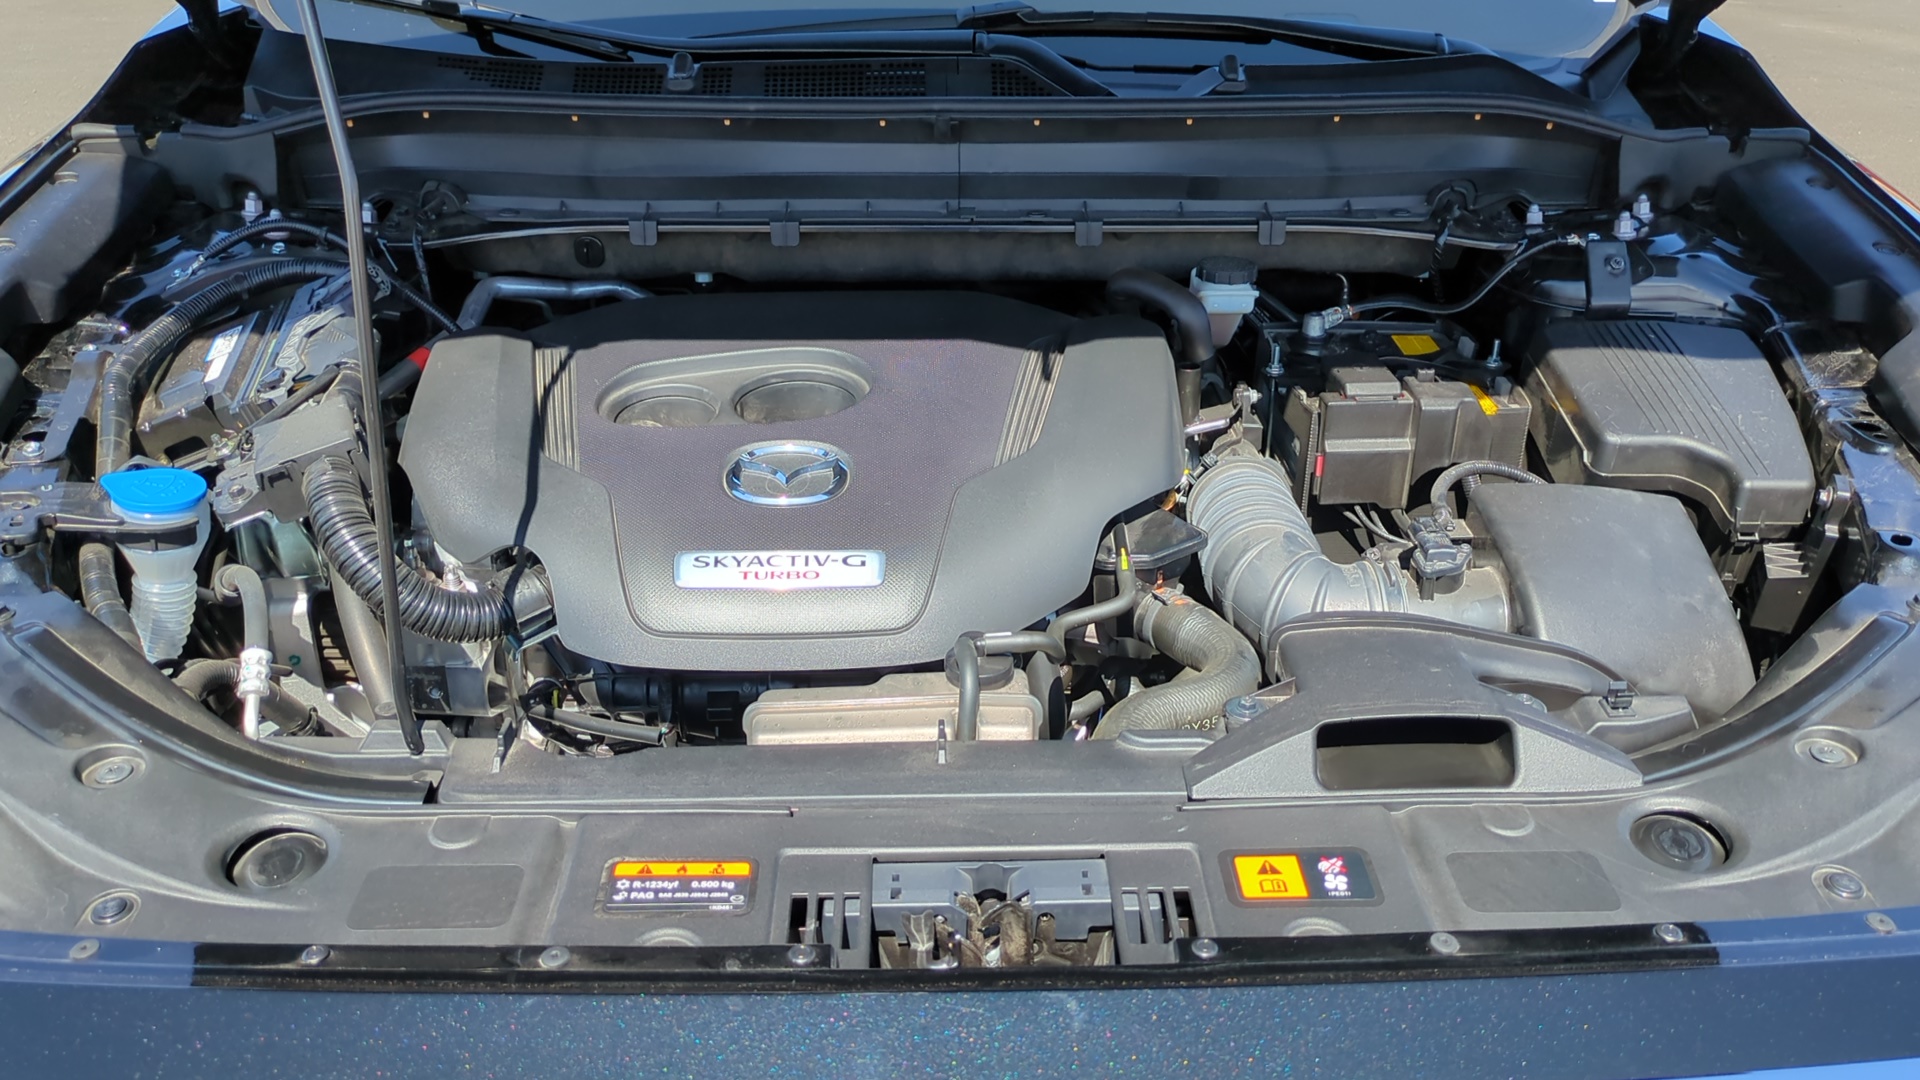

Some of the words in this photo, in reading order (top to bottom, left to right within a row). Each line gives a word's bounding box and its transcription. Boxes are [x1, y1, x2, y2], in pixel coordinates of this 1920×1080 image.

[692, 554, 867, 568] SKYACTIV-G
[738, 570, 820, 580] TURBO
[632, 880, 679, 890] R-1234yf
[721, 880, 735, 890] kg
[630, 891, 655, 900] PAG
